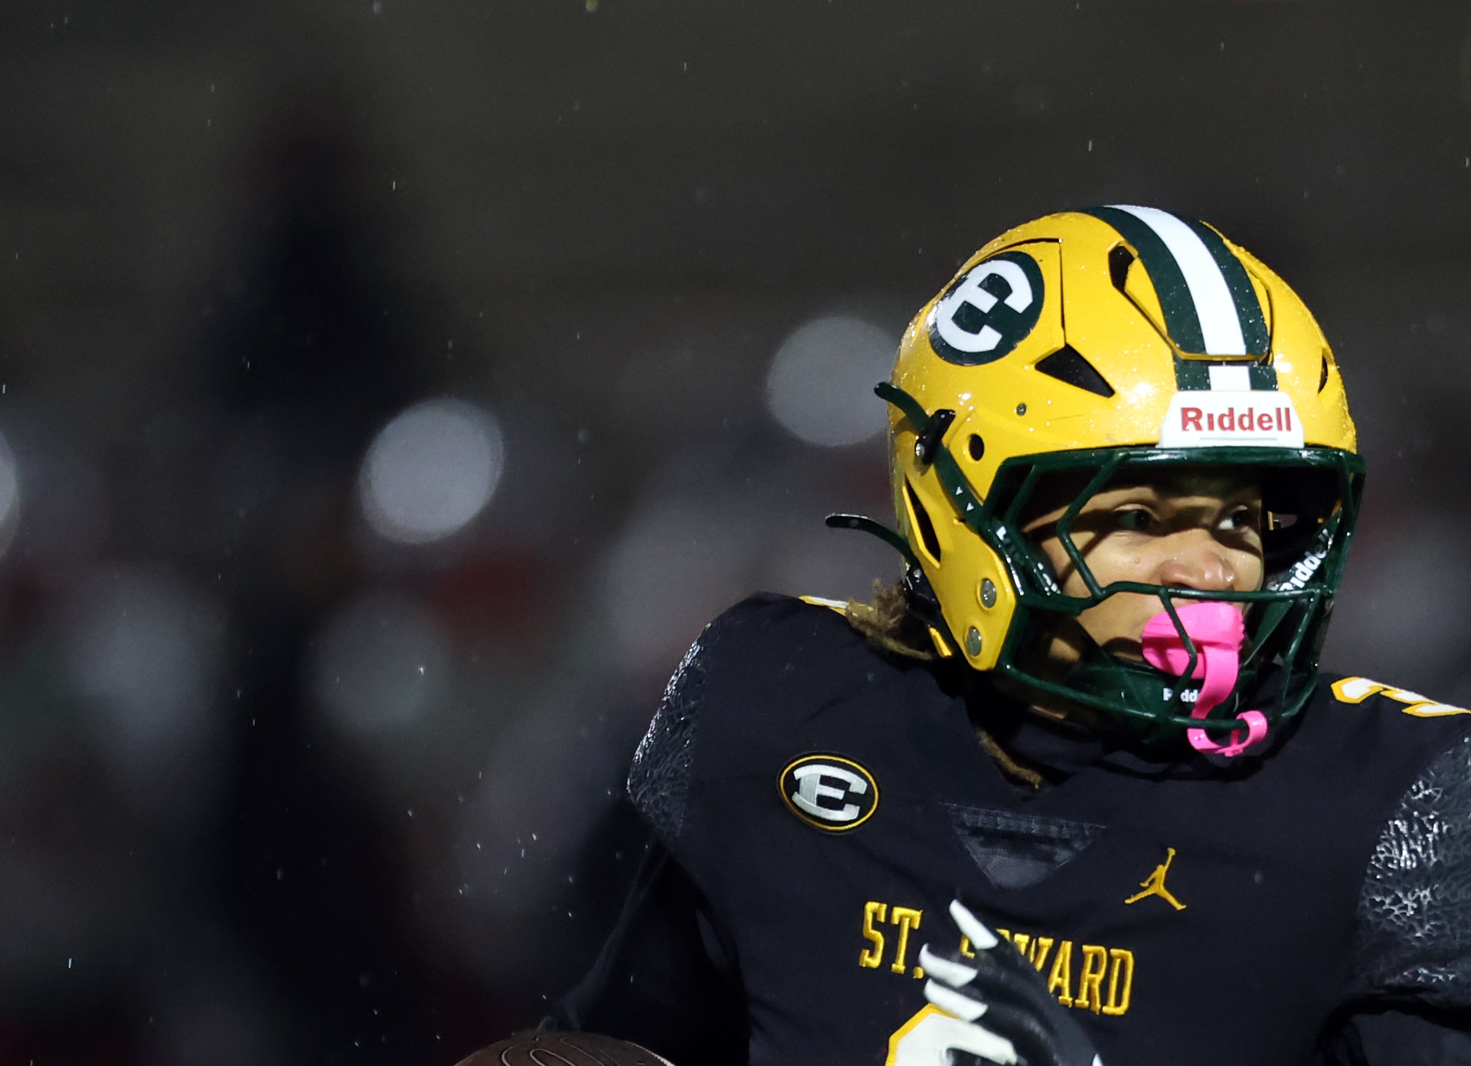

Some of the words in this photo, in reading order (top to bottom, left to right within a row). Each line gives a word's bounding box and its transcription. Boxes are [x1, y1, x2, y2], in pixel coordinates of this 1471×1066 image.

[937, 259, 1033, 353] E
[1179, 406, 1292, 432] Riddell
[791, 764, 868, 822] E
[859, 901, 925, 979] ST.
[959, 928, 1134, 1016] WARD
